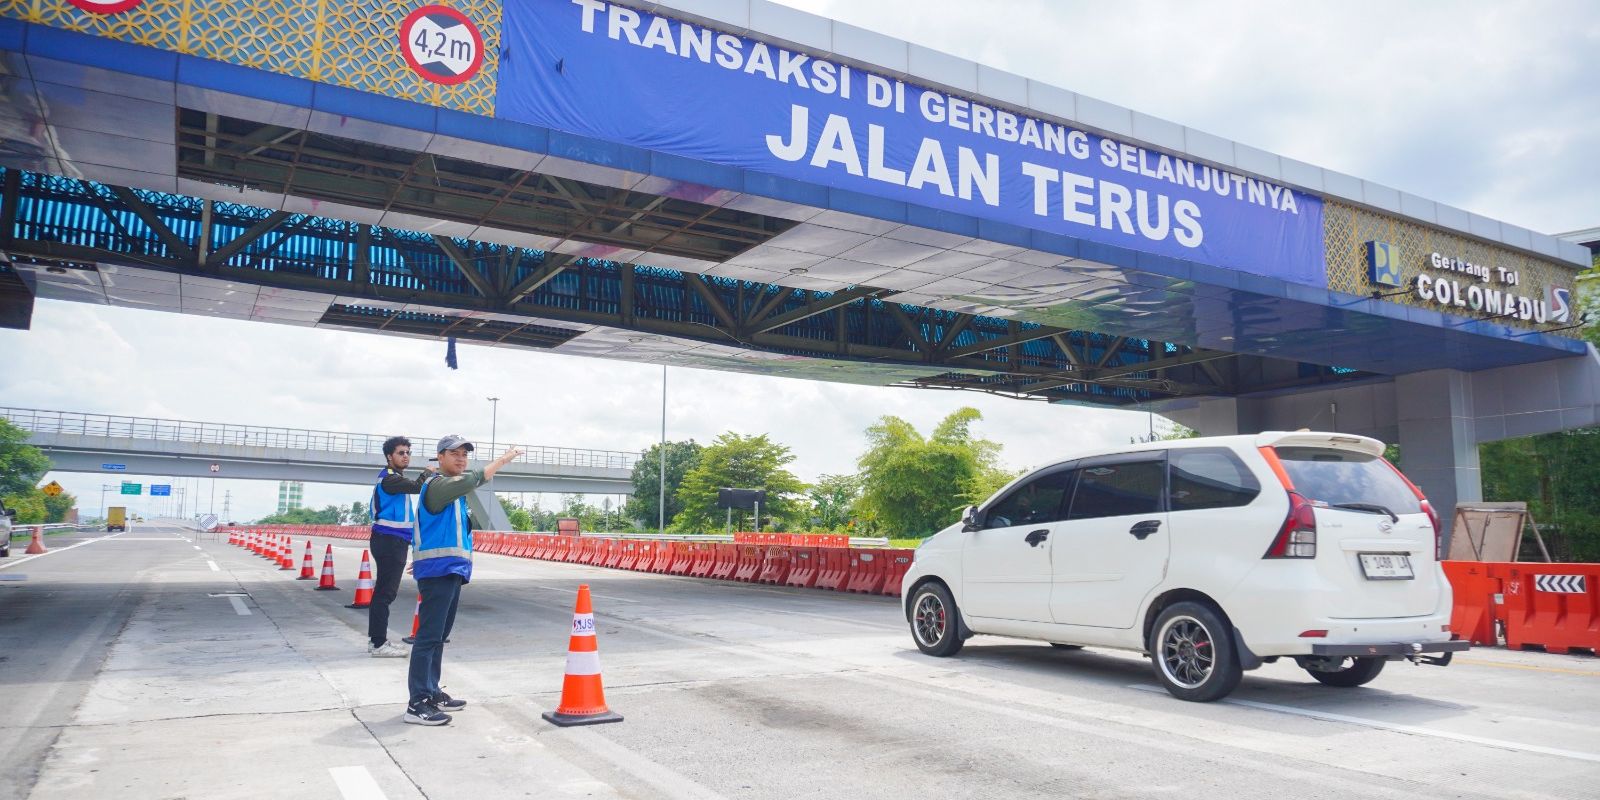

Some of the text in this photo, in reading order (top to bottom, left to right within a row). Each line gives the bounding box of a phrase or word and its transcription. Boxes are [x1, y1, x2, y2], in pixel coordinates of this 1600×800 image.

[571, 0, 1299, 214] TRANSAKSI DI GERBANG SELANJUTNYA
[765, 104, 1203, 248] JALAN TERUS
[1417, 273, 1546, 324] COLOMADU
[1431, 252, 1519, 286] Gerbang Tol
